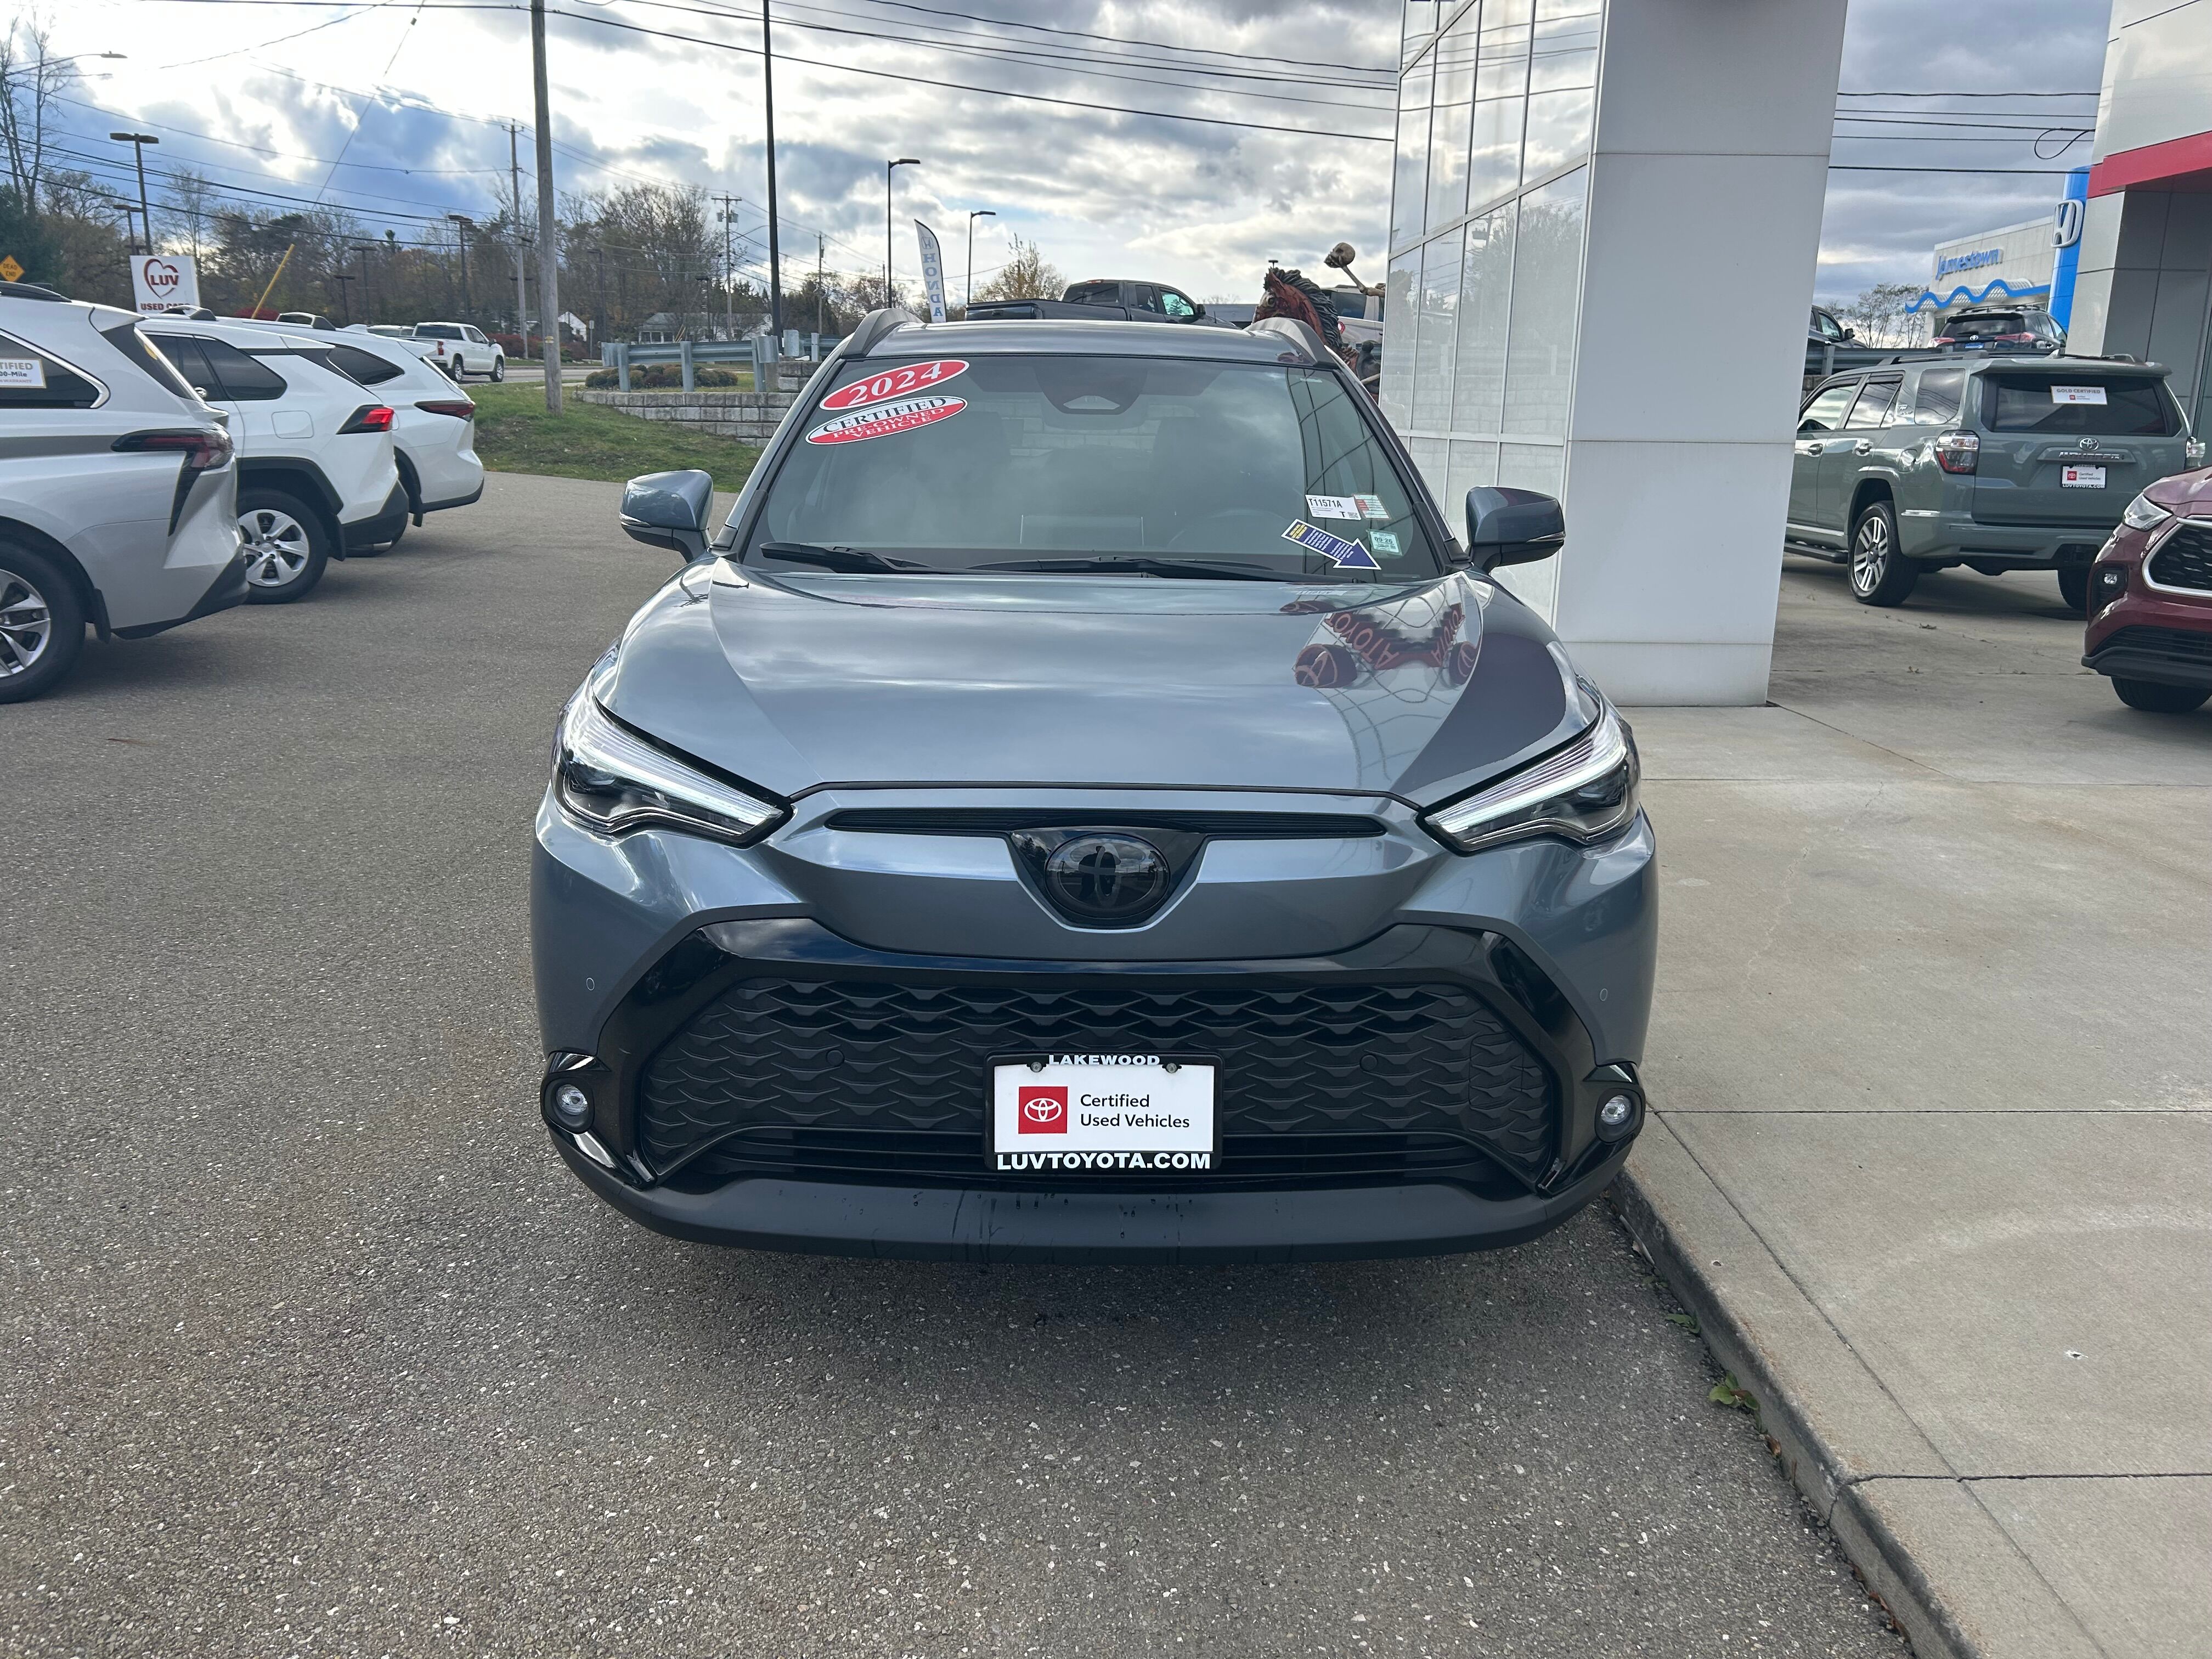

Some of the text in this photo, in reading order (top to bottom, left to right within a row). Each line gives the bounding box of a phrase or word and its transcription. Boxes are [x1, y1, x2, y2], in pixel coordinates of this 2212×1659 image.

[1935, 249, 2001, 280] Jamestown
[150, 275, 179, 285] LUV
[847, 362, 942, 406] 2024
[823, 398, 946, 432] CERTIFIED
[833, 408, 945, 439] PRE-OWNED
[851, 415, 932, 437] VEHICLE
[1308, 498, 1342, 508] T11571A
[1048, 1054, 1160, 1065] LAKEWOOD
[1080, 1094, 1150, 1107] Certified
[1081, 1114, 1190, 1128] Used Vehicles
[997, 1153, 1211, 1170] LUVTOYOTA.COM
